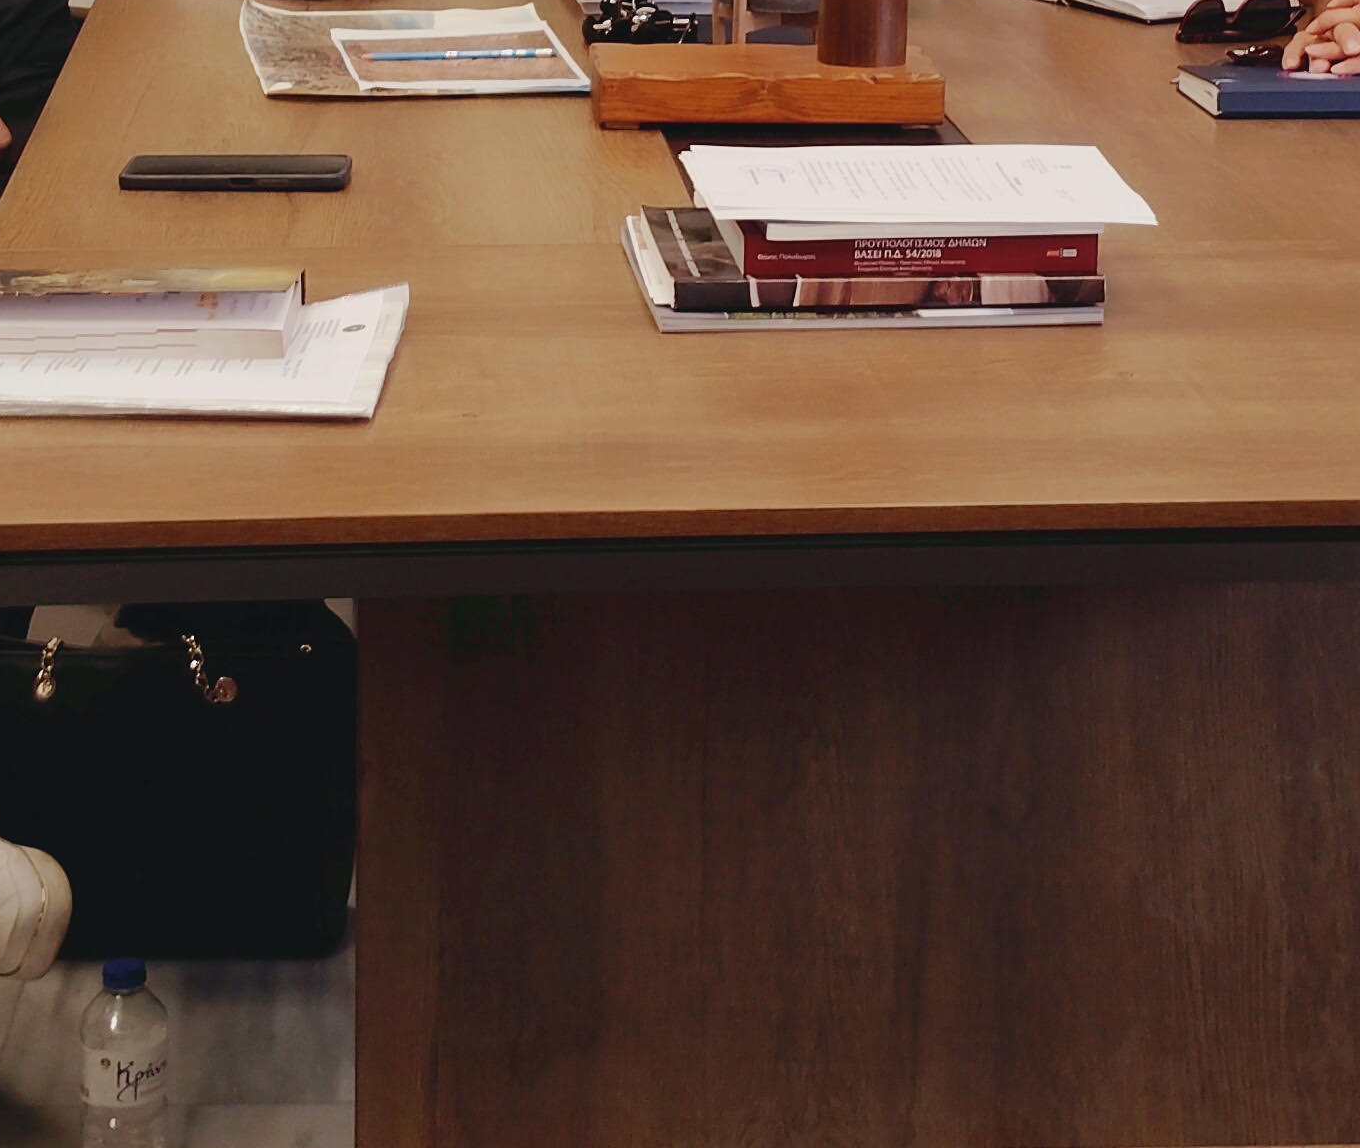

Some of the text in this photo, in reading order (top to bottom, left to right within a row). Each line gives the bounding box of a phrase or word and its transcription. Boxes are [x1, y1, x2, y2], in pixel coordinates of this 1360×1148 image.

[948, 237, 987, 248] ΔΗΜΩΝ
[854, 249, 882, 259] ΒΑΣΕΙ
[905, 249, 942, 259] 54/2018
